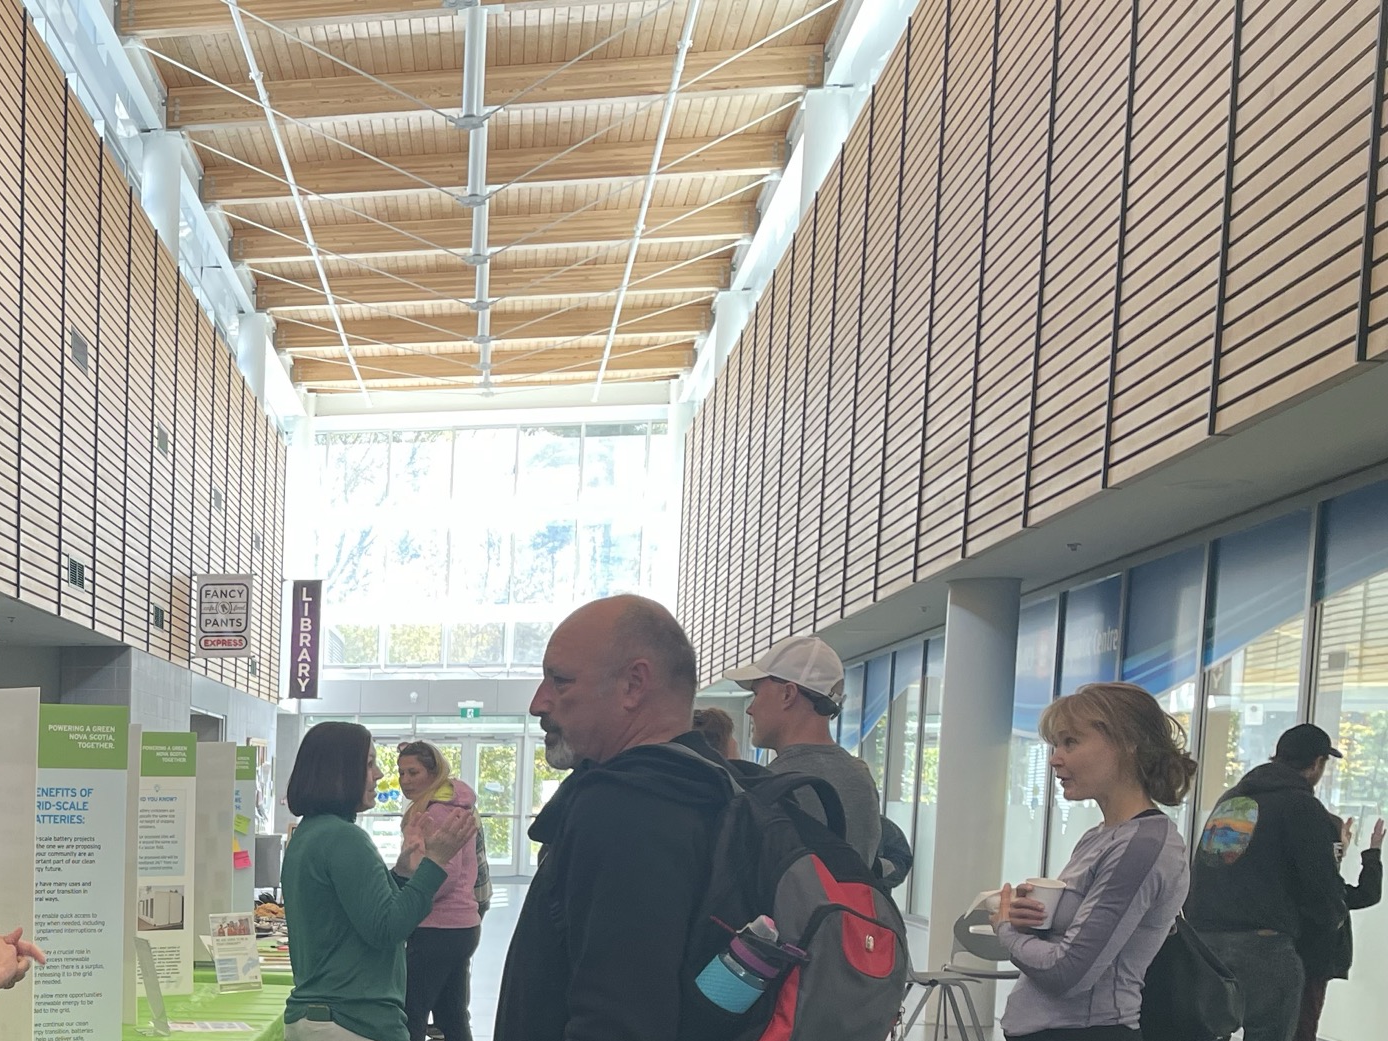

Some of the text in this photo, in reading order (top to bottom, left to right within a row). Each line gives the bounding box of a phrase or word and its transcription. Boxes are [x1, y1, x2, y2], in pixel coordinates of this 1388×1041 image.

[204, 589, 244, 598] FANCY
[204, 618, 243, 628] PANTS
[203, 638, 244, 648] EXPRESS
[296, 587, 313, 693] LIBRARY
[48, 724, 84, 732] POWERING
[80, 788, 94, 797] OF
